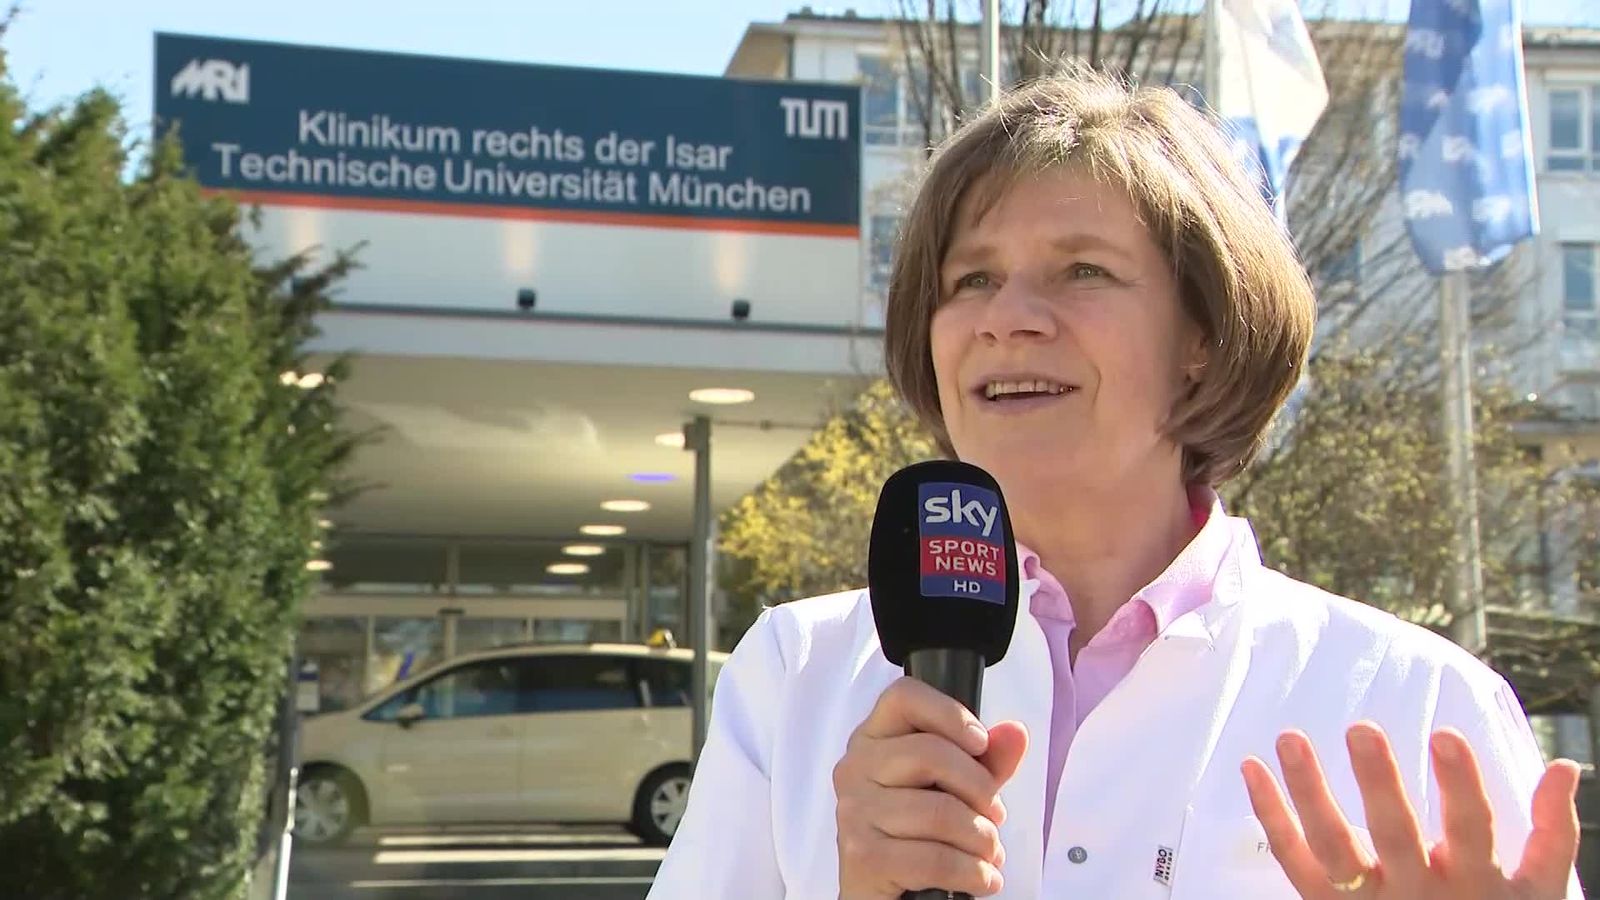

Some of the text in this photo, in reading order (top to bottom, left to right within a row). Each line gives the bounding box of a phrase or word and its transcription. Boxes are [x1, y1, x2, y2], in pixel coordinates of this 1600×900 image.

[171, 59, 250, 104] MRI
[781, 97, 848, 139] TUM
[298, 109, 734, 171] Klinikum rechts der Isar
[212, 143, 812, 212] Technische Universität München
[924, 489, 998, 537] sky
[929, 540, 1000, 560] SPORT
[935, 556, 997, 576] NEWS
[953, 580, 981, 593] HD
[1155, 848, 1167, 878] NYBO
